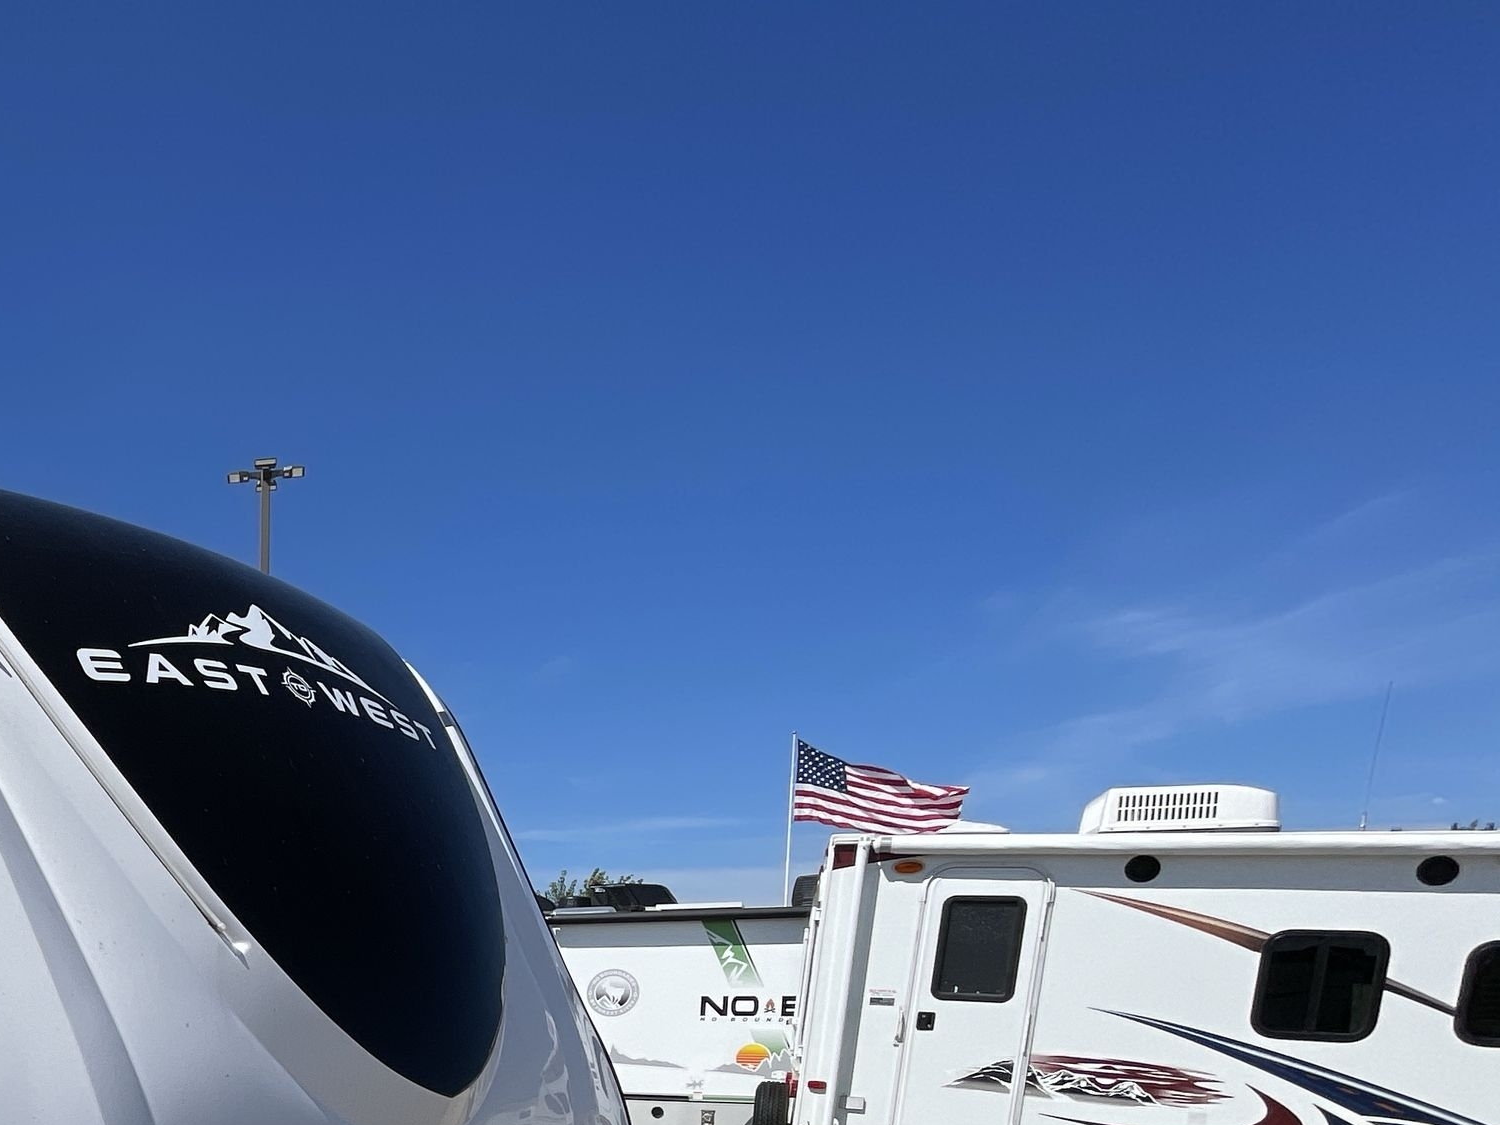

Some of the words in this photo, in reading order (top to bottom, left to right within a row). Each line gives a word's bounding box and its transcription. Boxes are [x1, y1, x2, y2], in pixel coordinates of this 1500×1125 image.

[77, 648, 270, 696] EAST
[317, 681, 437, 750] WEST
[700, 996, 759, 1016] NO
